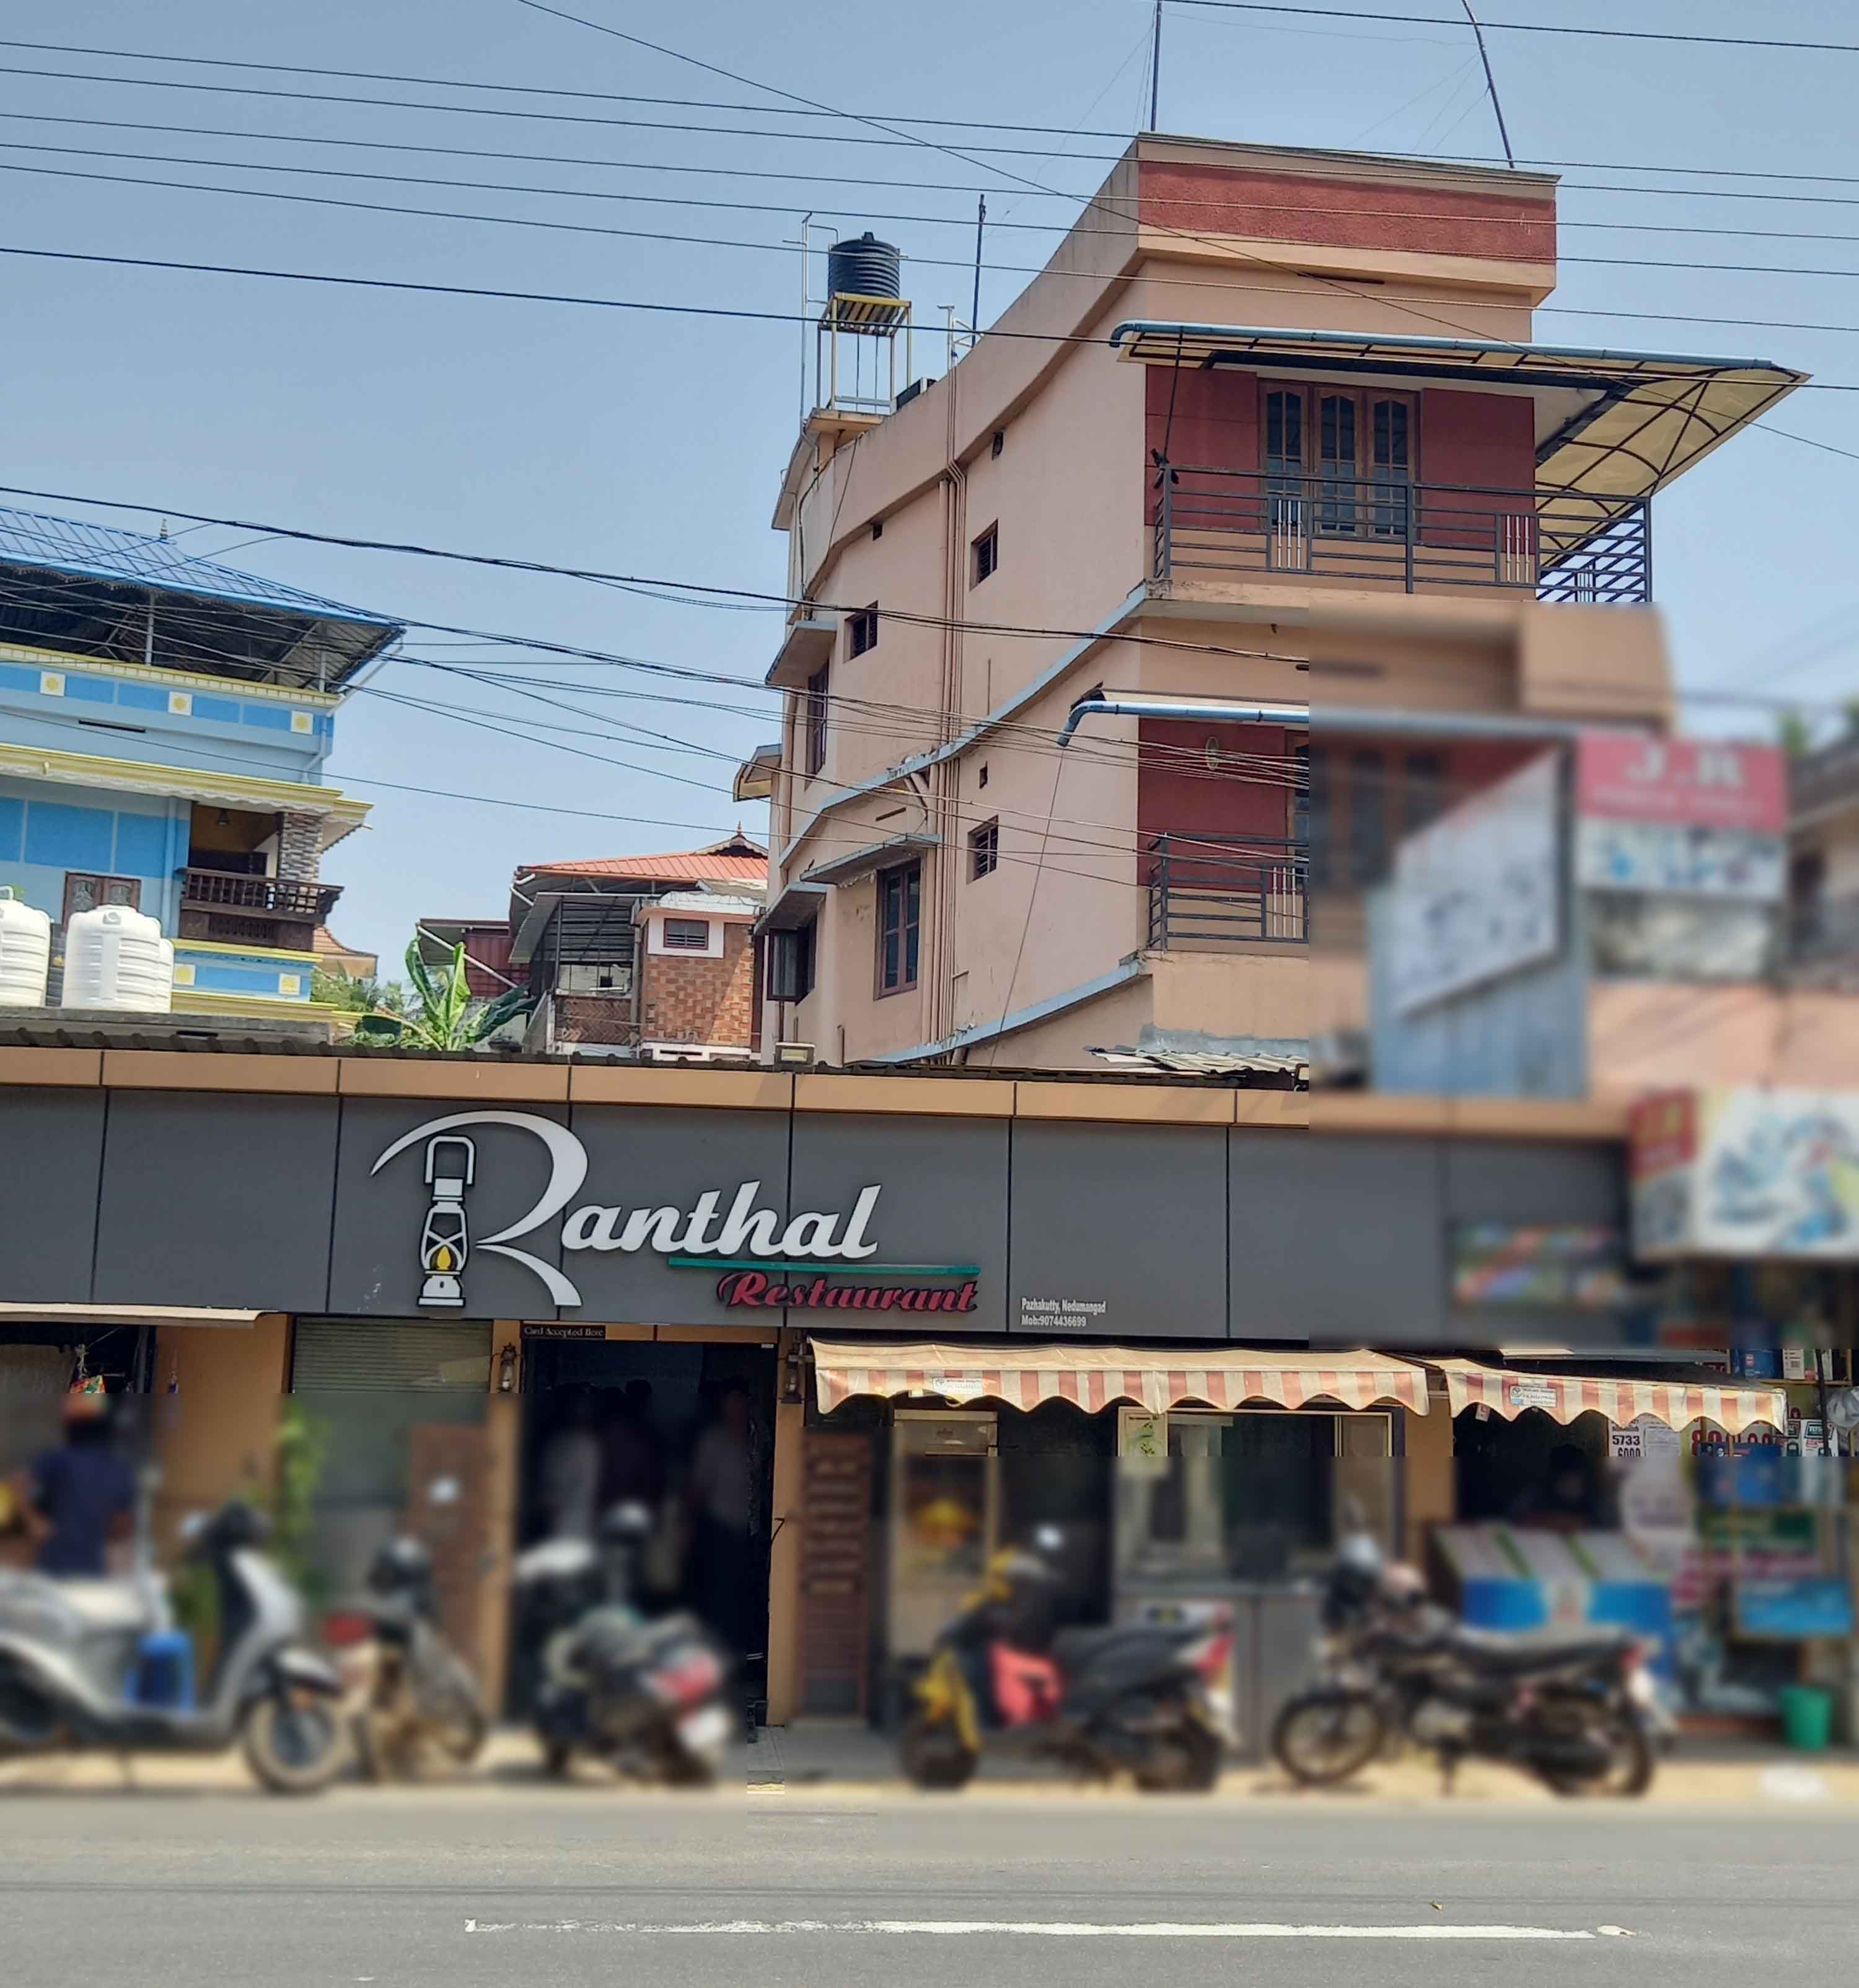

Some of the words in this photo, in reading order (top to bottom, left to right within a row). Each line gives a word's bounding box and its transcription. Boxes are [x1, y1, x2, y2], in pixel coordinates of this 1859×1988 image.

[371, 1110, 882, 1307] Ranthal
[717, 1270, 978, 1313] Restaurant
[1062, 1299, 1106, 1316] Nedumangad
[546, 1327, 582, 1337] Accepted
[1612, 1435, 1640, 1445] 5733
